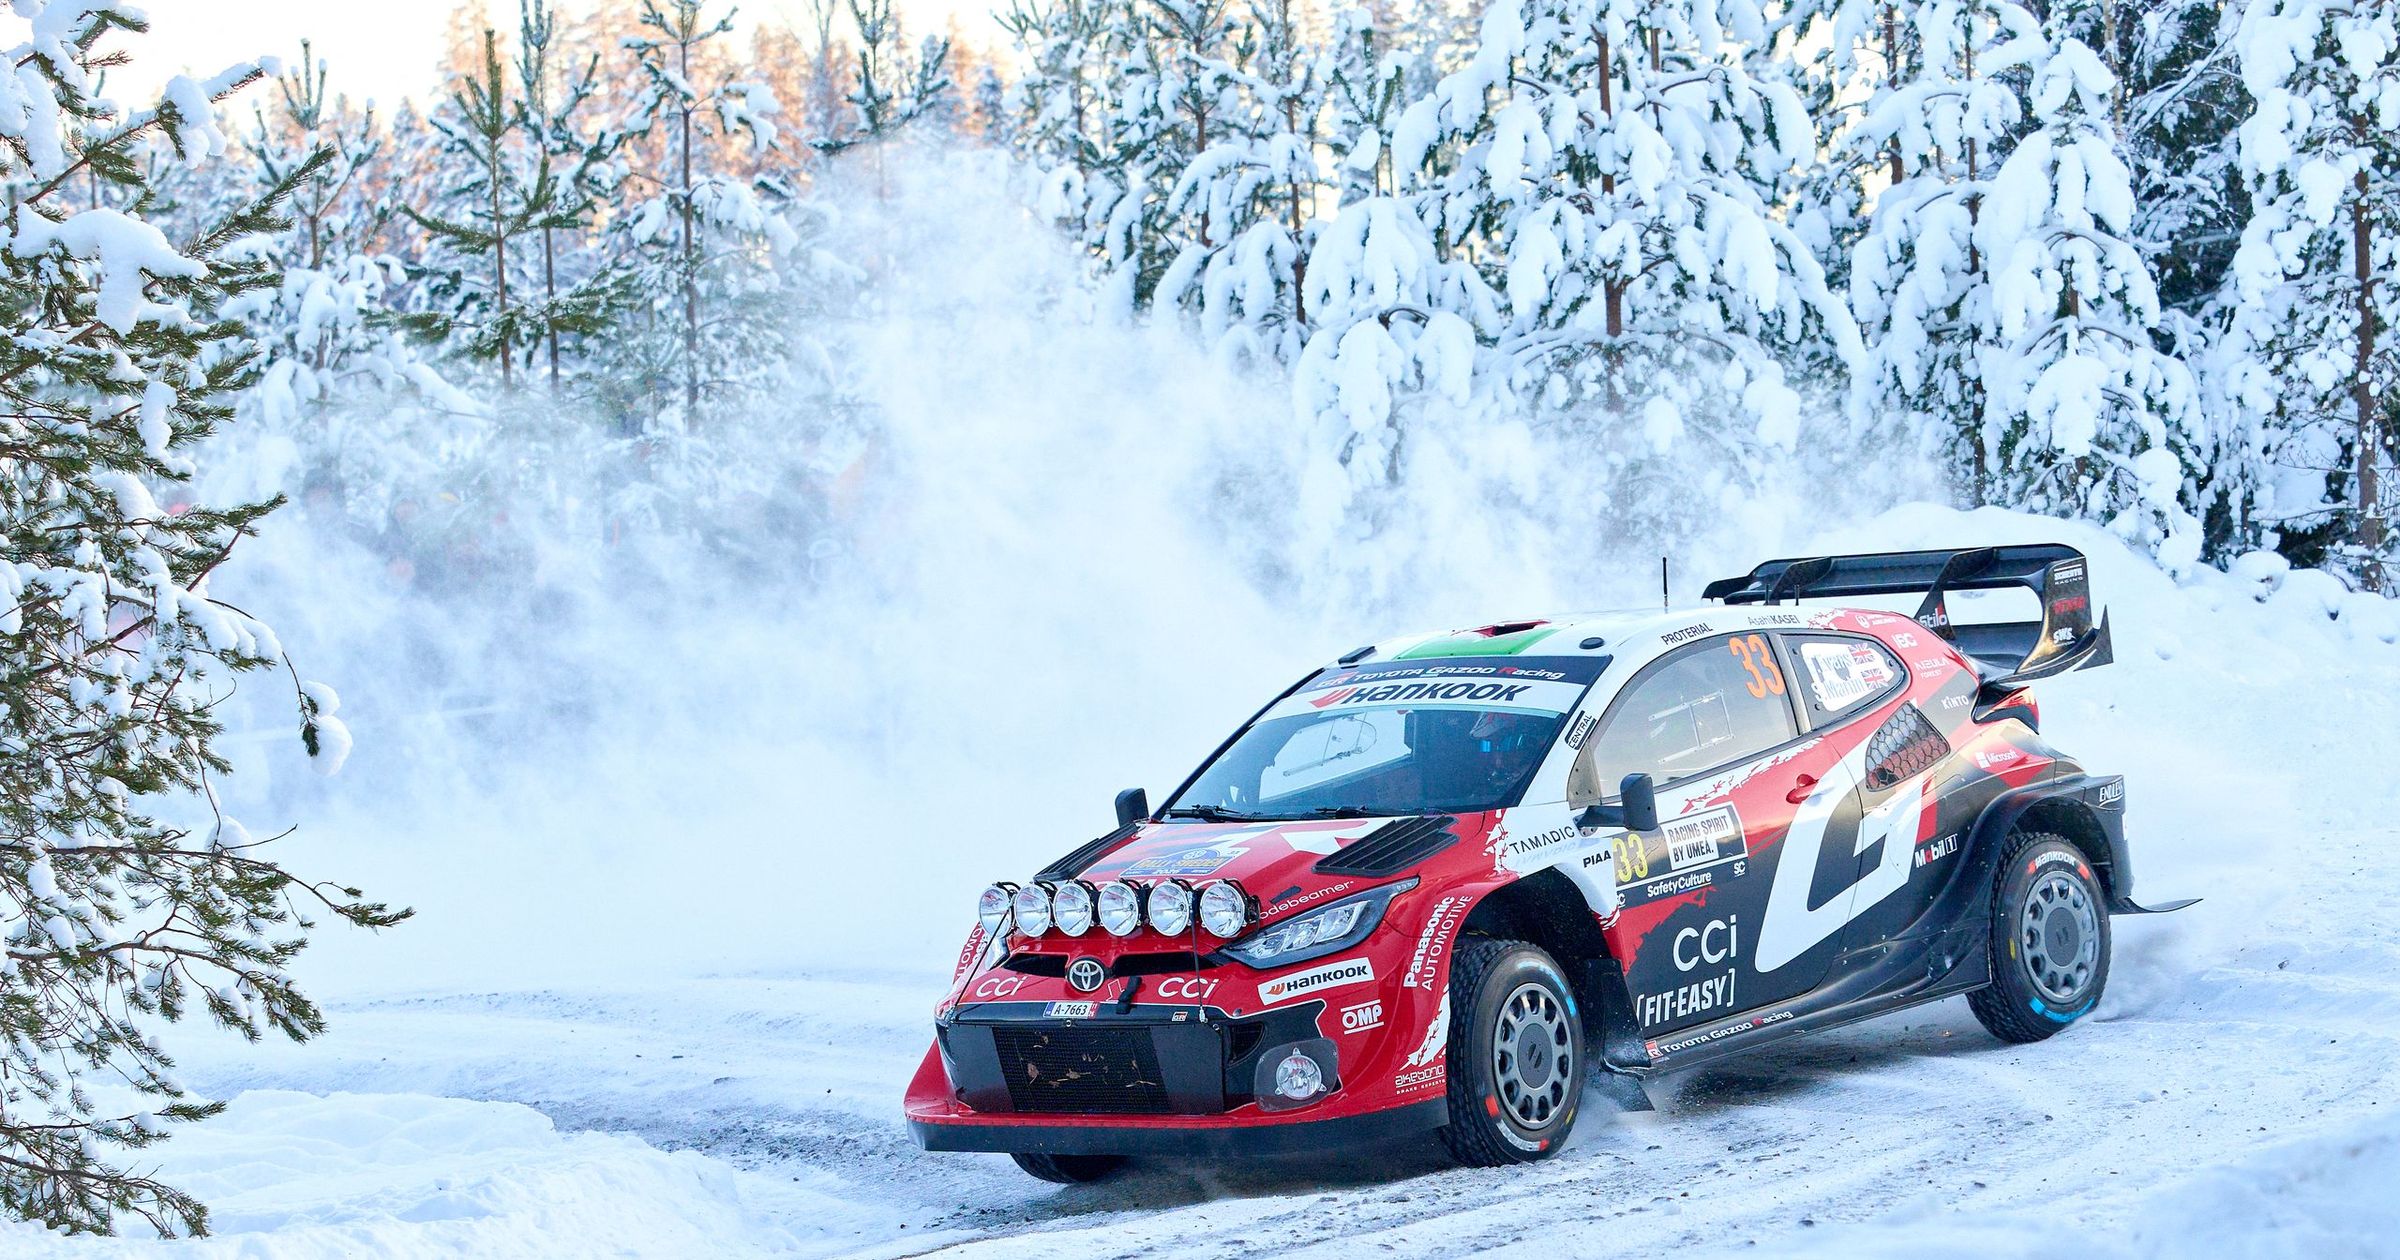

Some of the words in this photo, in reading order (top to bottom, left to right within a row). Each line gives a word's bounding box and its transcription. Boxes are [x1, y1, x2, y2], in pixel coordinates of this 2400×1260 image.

[1919, 608, 1947, 629] Stilo
[1661, 622, 1713, 645] PROTERIAL
[1355, 668, 1421, 681] TOYOTA
[1421, 666, 1497, 679] GAZOO
[1497, 667, 1565, 680] Racing
[1729, 634, 1785, 698] 33
[1568, 714, 1593, 749] CENTRAL
[1986, 749, 2019, 764] Microsoft
[1509, 826, 1575, 854] TAMADIC
[1668, 821, 1699, 845] RACING
[1700, 814, 1729, 836] SPIRIT
[1583, 850, 1611, 868] PIAA
[1612, 833, 1648, 882] 33
[1673, 848, 1685, 862] BY
[1914, 839, 1945, 868] Mobil
[1734, 861, 1746, 874] SC
[1647, 872, 1712, 897] SafetyCulture
[1260, 882, 1351, 919] odebeamer
[1403, 896, 1456, 988] Panasonic
[1421, 896, 1474, 991] AUTOMOTIVE
[1286, 964, 1368, 991] HANKOOK
[1054, 1004, 1088, 1016] A-7663
[1342, 1004, 1383, 1029] OMP
[1660, 1033, 1710, 1053] TOYOTA
[1710, 1022, 1753, 1039] GAZOO
[1753, 1010, 1794, 1027] Racing
[1395, 1064, 1445, 1085] akebono
